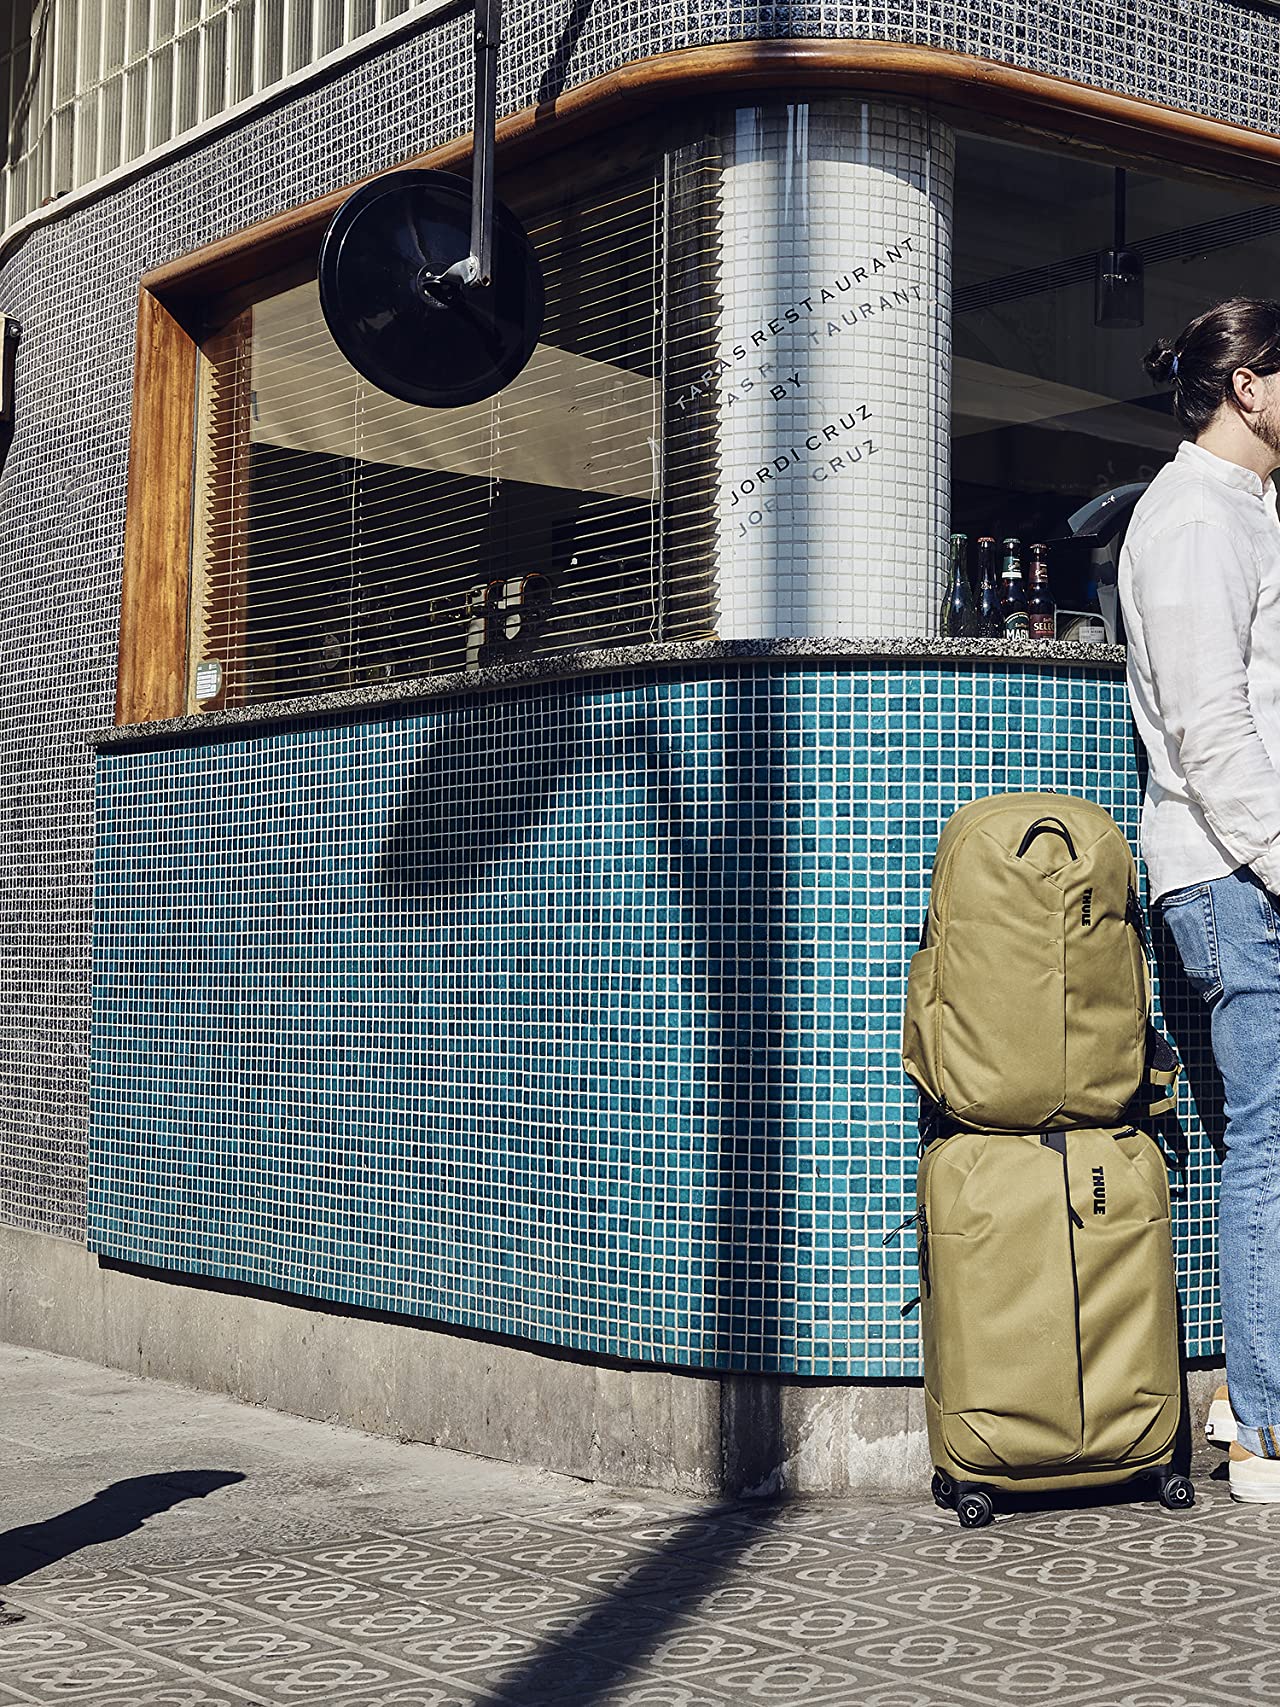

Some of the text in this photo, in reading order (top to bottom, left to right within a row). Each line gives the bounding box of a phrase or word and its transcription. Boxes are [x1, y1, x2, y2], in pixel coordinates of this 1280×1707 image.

[674, 237, 916, 410] TAPAS RESTAURANT
[769, 371, 803, 402] BY
[730, 404, 873, 506] JORDI CRUZ
[1081, 888, 1093, 926] THULE
[1092, 1166, 1105, 1214] THULE
